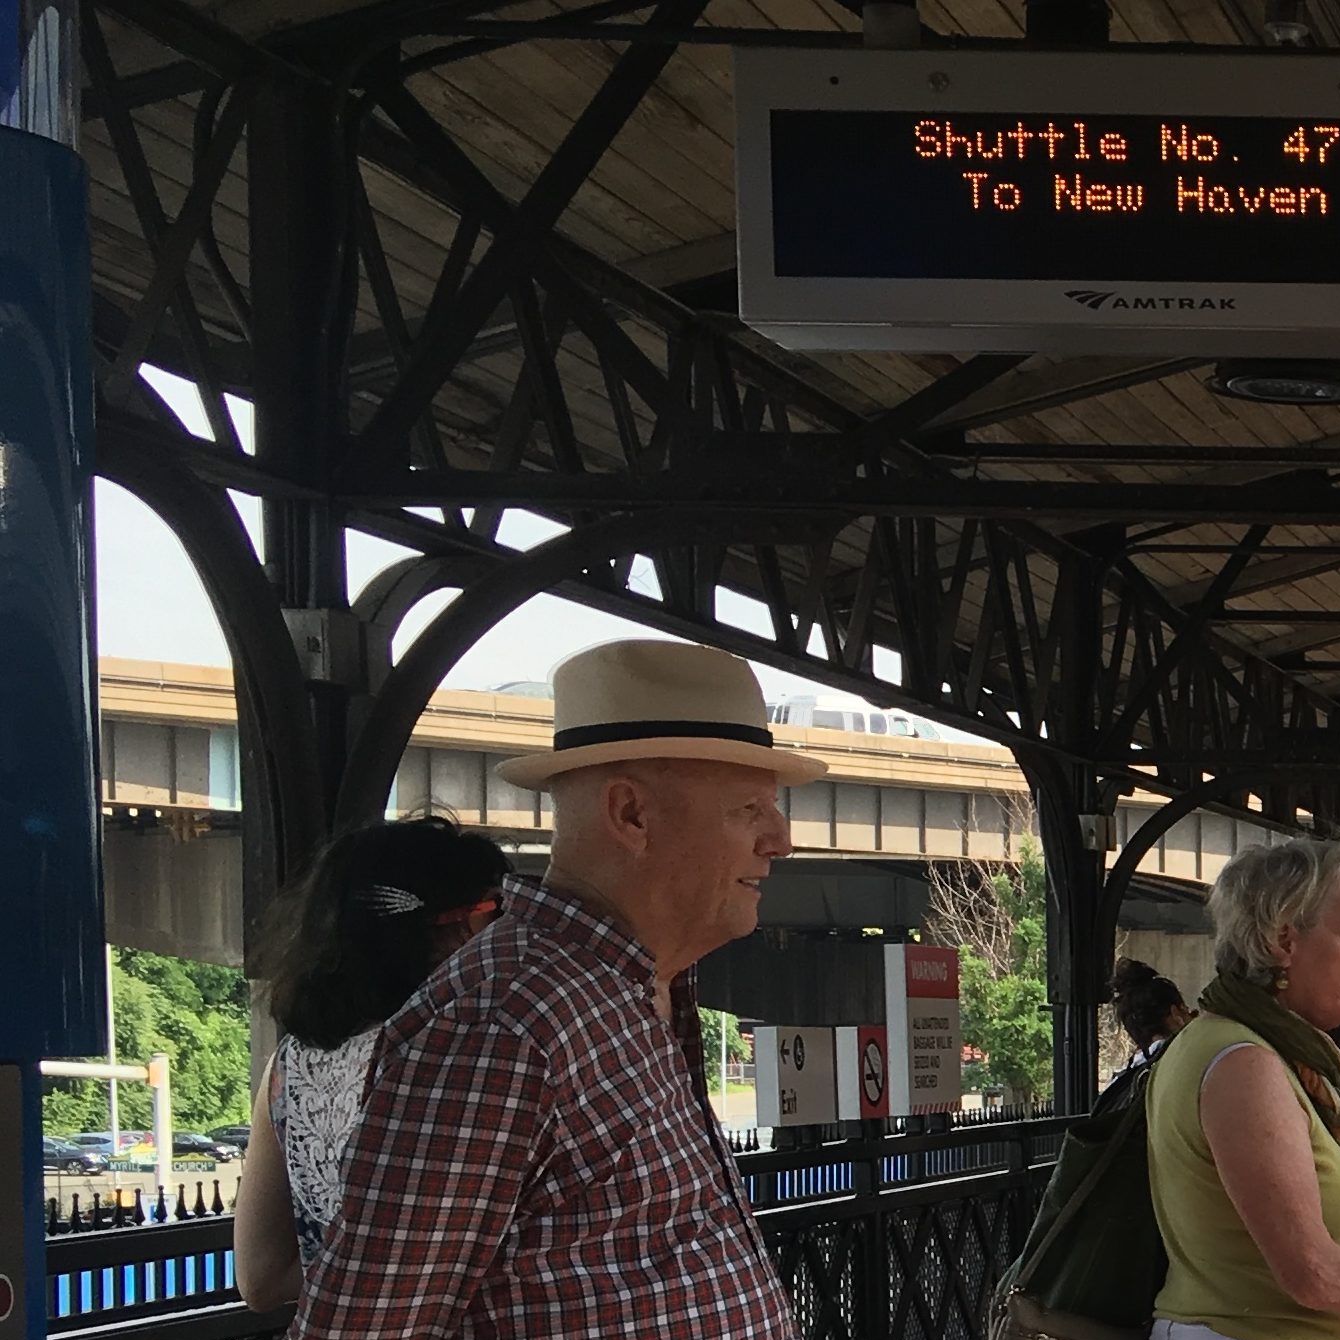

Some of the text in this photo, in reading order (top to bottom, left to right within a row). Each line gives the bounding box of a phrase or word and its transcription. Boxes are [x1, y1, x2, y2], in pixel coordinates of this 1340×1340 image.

[914, 120, 1128, 160] Shuttle
[1161, 123, 1239, 163] No.
[962, 171, 1328, 214] To New Haven
[1111, 297, 1237, 310] AMTRAK
[911, 960, 948, 982] WARNING
[781, 1088, 798, 1115] Exit
[109, 1161, 142, 1172] MYRTLE
[173, 1161, 208, 1172] CHURCH
